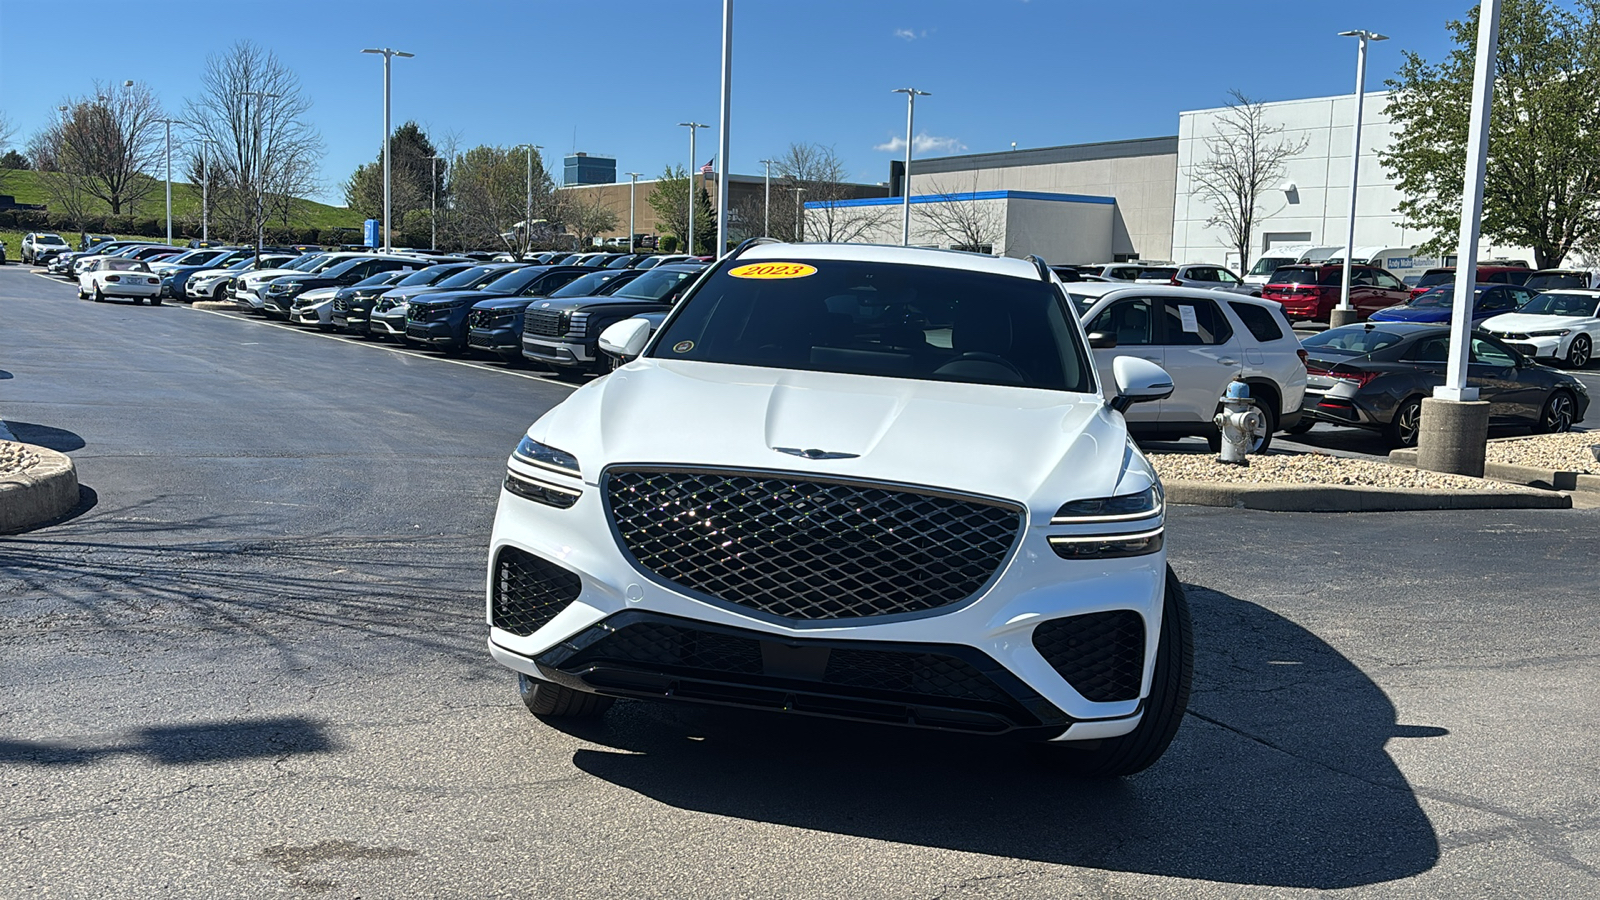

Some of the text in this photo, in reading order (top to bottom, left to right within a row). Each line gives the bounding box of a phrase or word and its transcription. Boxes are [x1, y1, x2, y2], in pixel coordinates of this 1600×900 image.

[1389, 259, 1399, 269] Andy
[1401, 259, 1412, 267] Mohr
[741, 266, 804, 275] 2023
